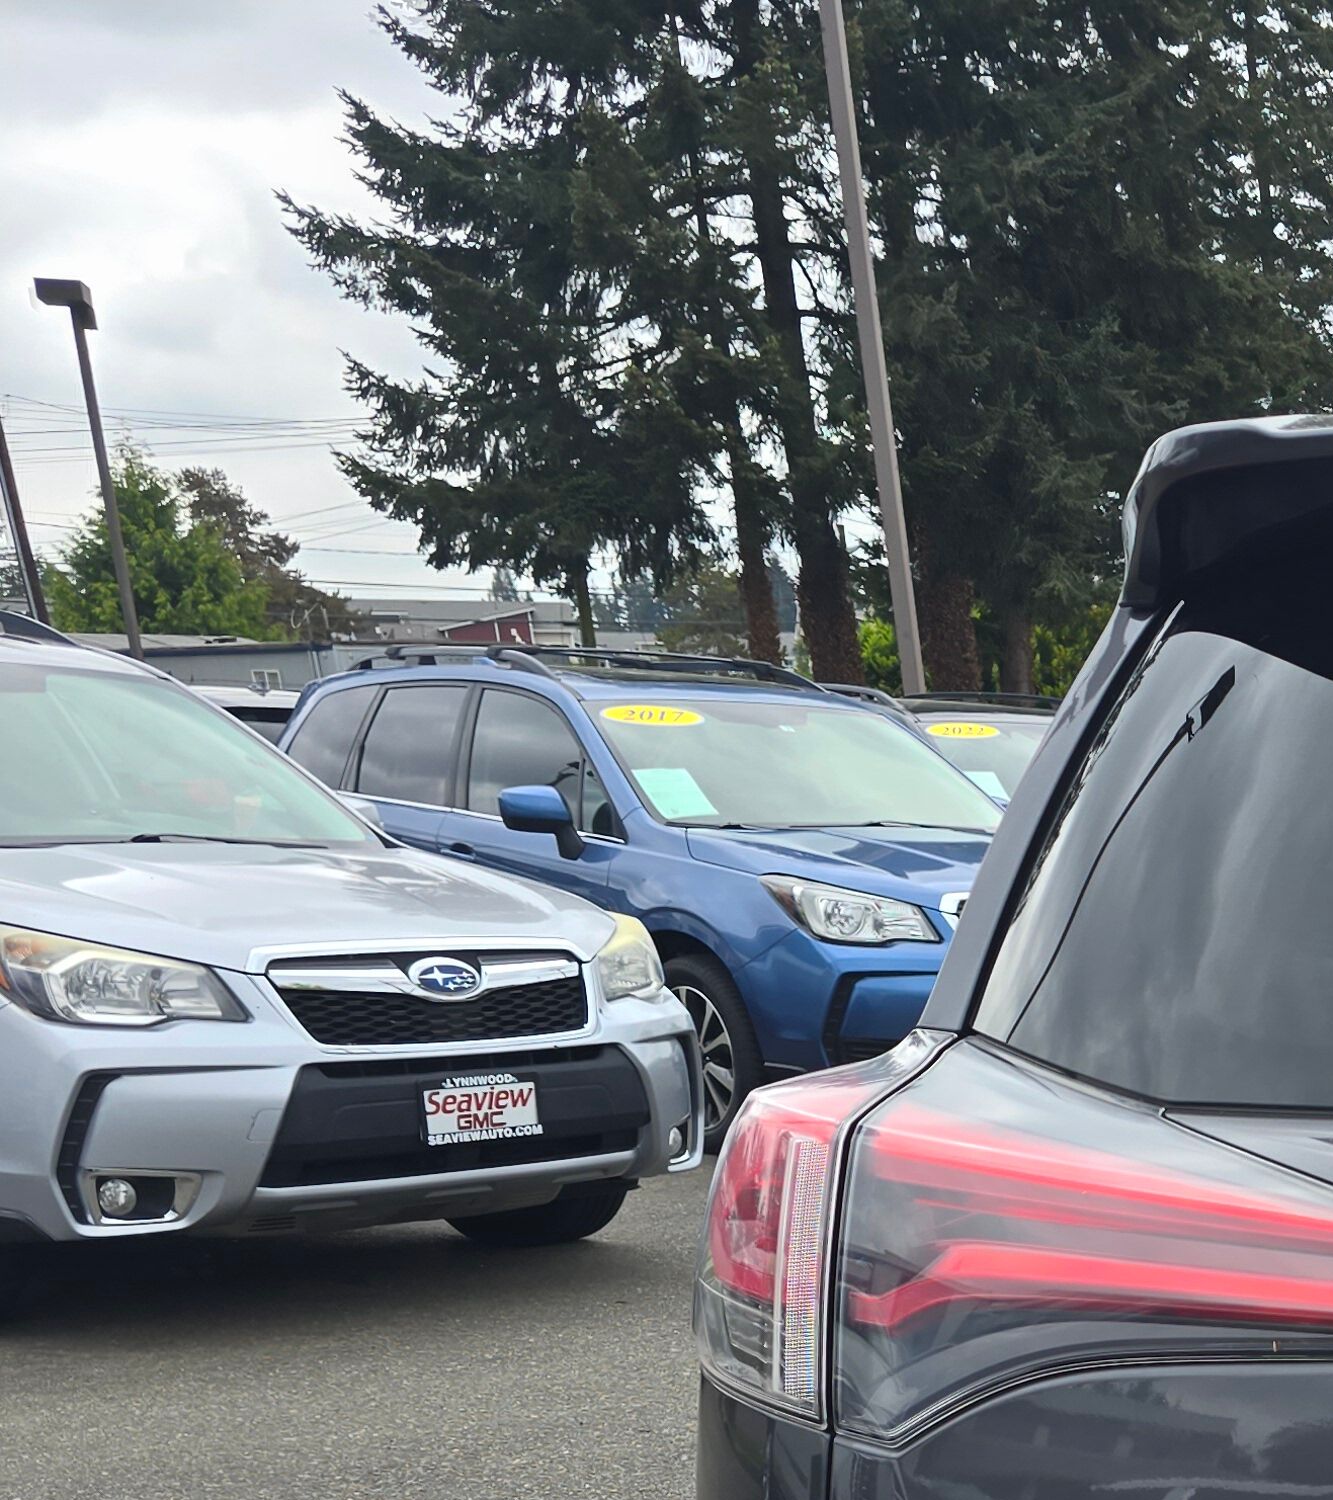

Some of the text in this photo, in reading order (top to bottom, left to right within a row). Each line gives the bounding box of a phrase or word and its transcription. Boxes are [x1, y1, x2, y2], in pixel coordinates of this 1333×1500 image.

[623, 709, 684, 722] 2017
[446, 1073, 515, 1088] LYNNWOOD
[426, 1086, 533, 1116] Seaview
[457, 1110, 507, 1131] GMC
[427, 1124, 543, 1146] SEAVIEWAUTO.COM
